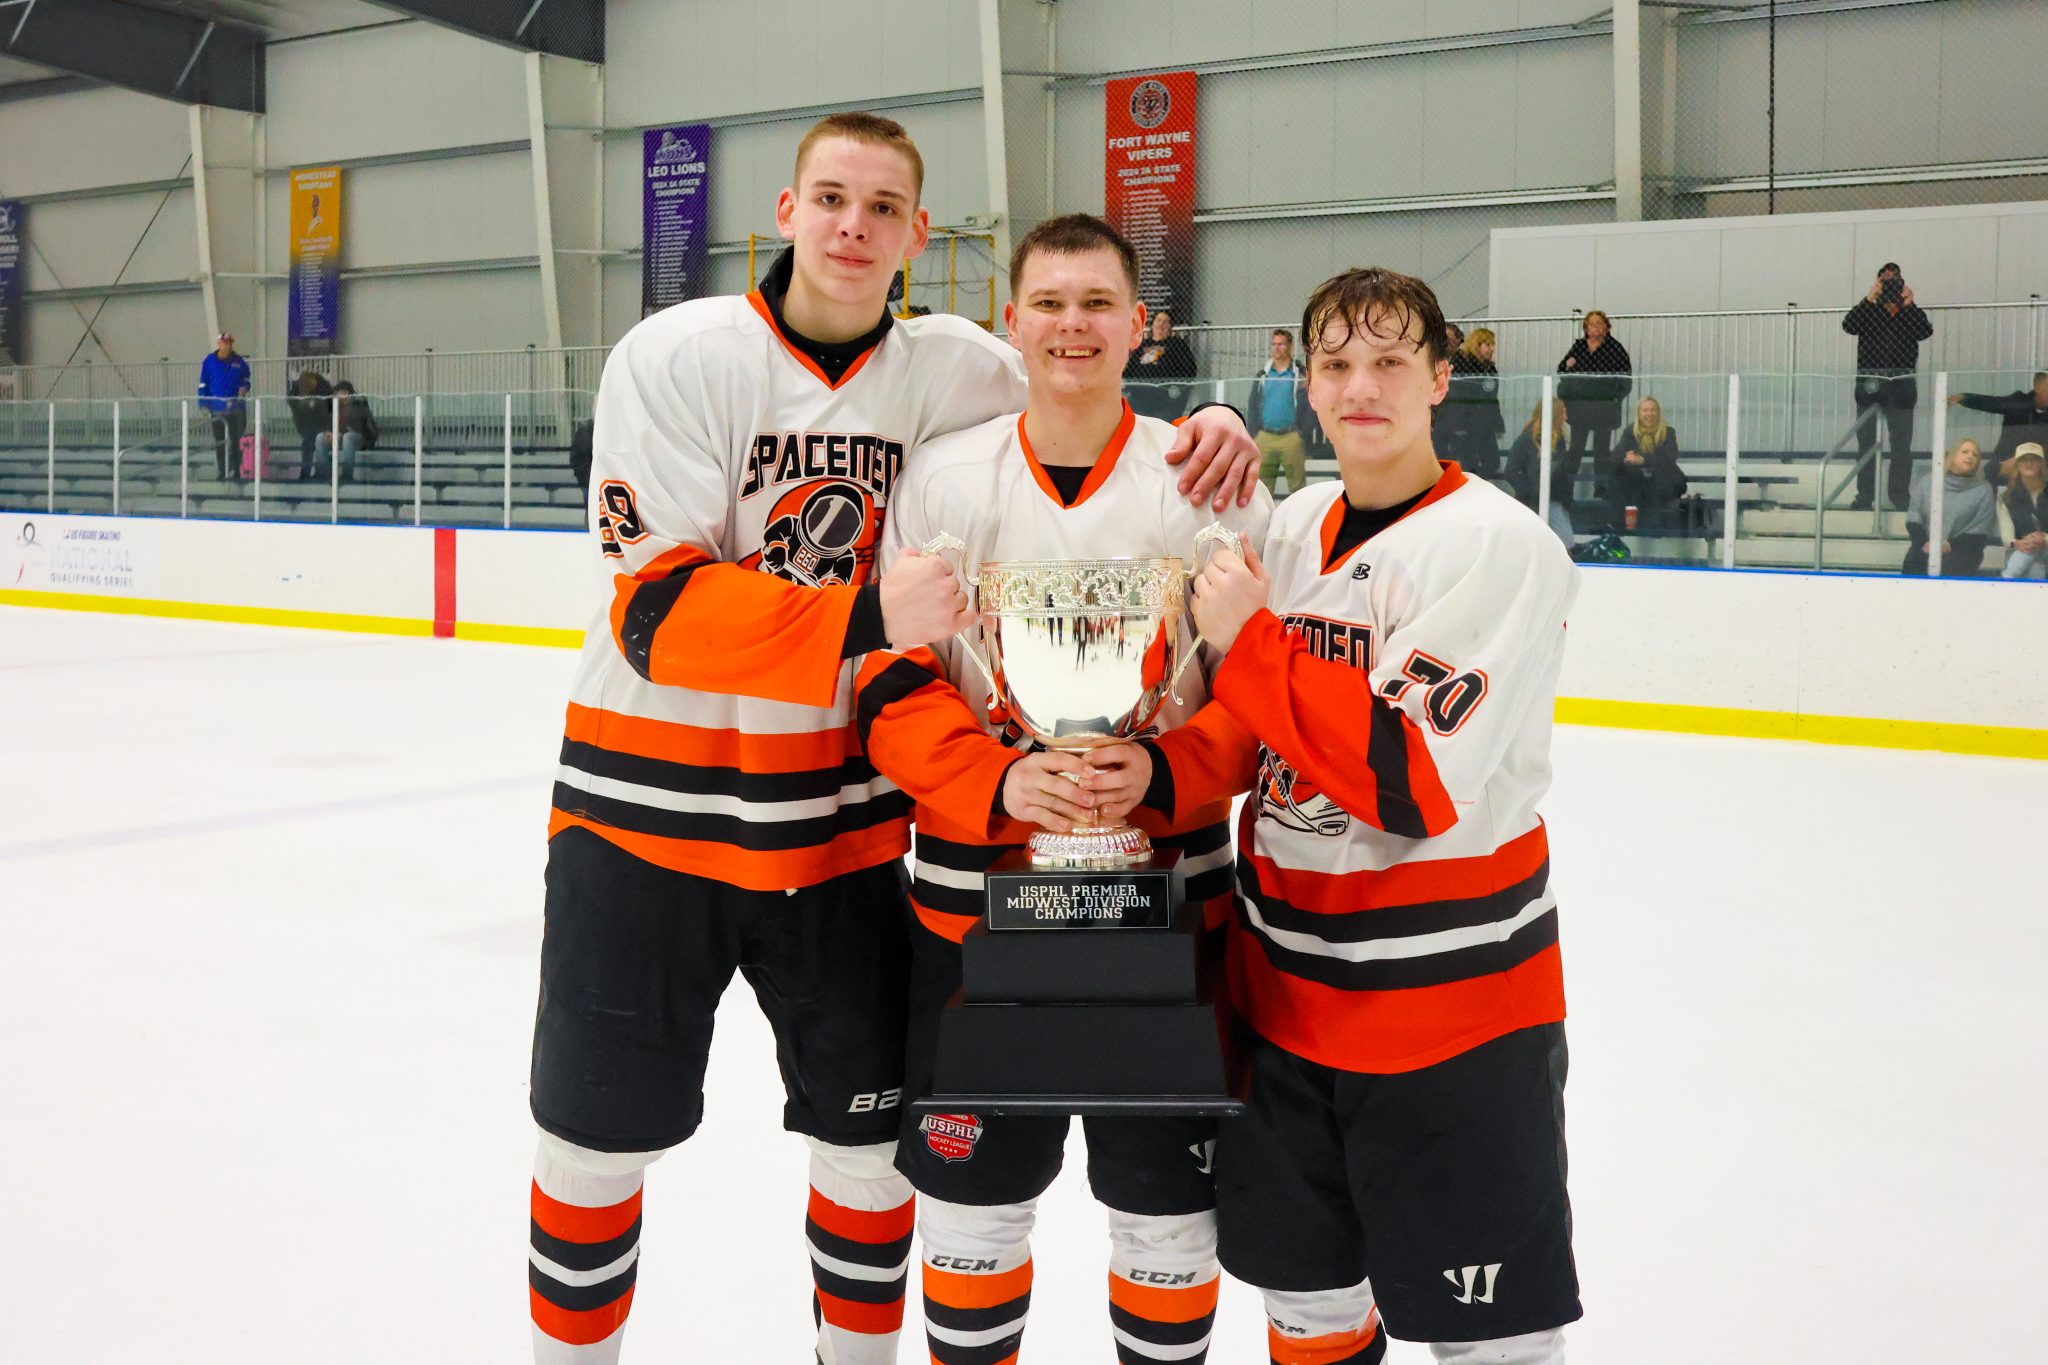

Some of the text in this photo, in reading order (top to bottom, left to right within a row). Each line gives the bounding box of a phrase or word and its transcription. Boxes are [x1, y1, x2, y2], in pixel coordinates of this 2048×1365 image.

[1109, 131, 1191, 149] FORT WAYNE
[1126, 147, 1173, 161] VIPERS
[648, 162, 706, 178] LEO LIONS
[1123, 175, 1176, 186] CHAMPIONS
[1379, 649, 1488, 737] 70
[1019, 884, 1137, 898] USPHL PREMIER
[1007, 895, 1151, 909] MIDWEST DIVISION
[1035, 907, 1123, 920] CHAMPIONS
[927, 1117, 975, 1139] USPHL
[930, 1135, 970, 1150] HOCKEY LEAGUE
[931, 1254, 999, 1271] CCM
[1129, 1268, 1197, 1285] CCM
